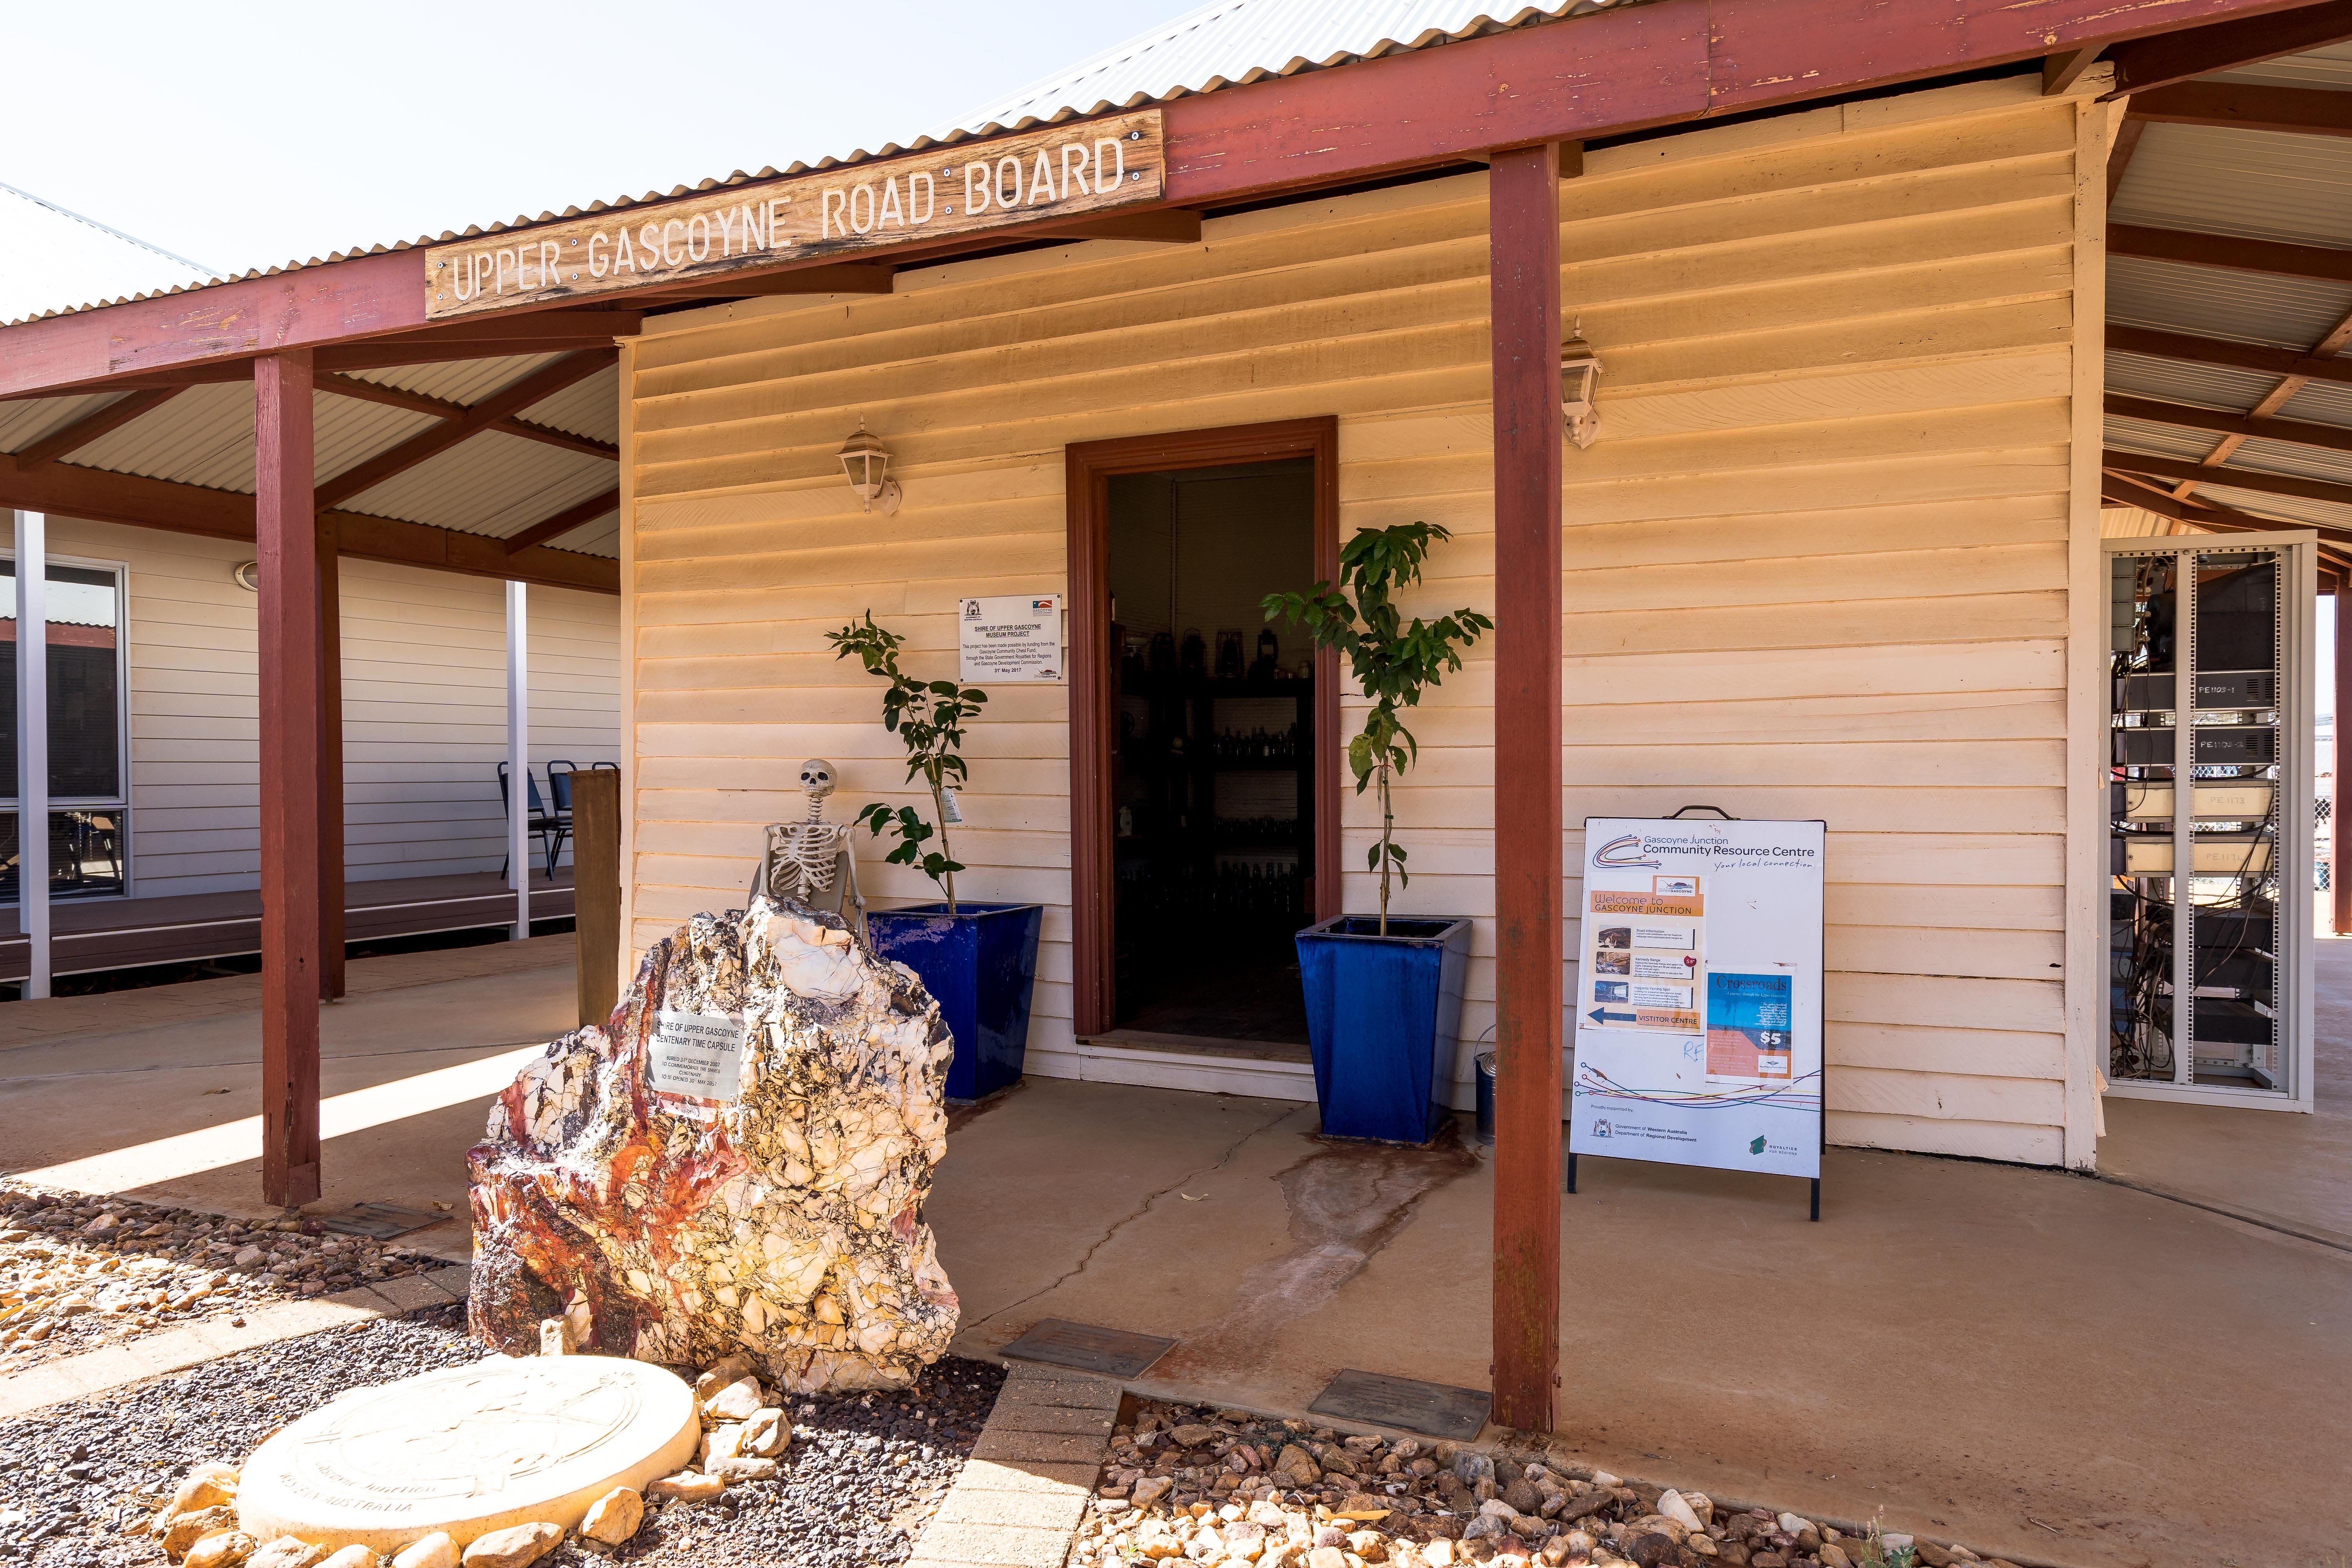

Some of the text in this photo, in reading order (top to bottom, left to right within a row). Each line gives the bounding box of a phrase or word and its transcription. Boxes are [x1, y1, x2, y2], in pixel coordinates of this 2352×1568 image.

[454, 136, 1125, 301] UPPER GASCOYNE ROAD BOARD
[1644, 836, 1728, 845] Gascoyne Junction
[1643, 844, 1815, 857] Community Resource Centre
[1739, 858, 1761, 868] local
[1764, 859, 1812, 868] connection
[1595, 894, 1663, 905] Welcome to
[1595, 904, 1691, 915] GASCOYNE JUNCTION
[1716, 975, 1787, 991] Crossroads
[657, 1020, 739, 1038] SHIRE OF UPPER GASCOYNE
[657, 1034, 736, 1052] CENTENARY TIME CAPSULE
[1760, 1031, 1781, 1044] $5
[668, 1062, 699, 1071] COMMEMORATE
[323, 1496, 413, 1512] AUSTRALIA
